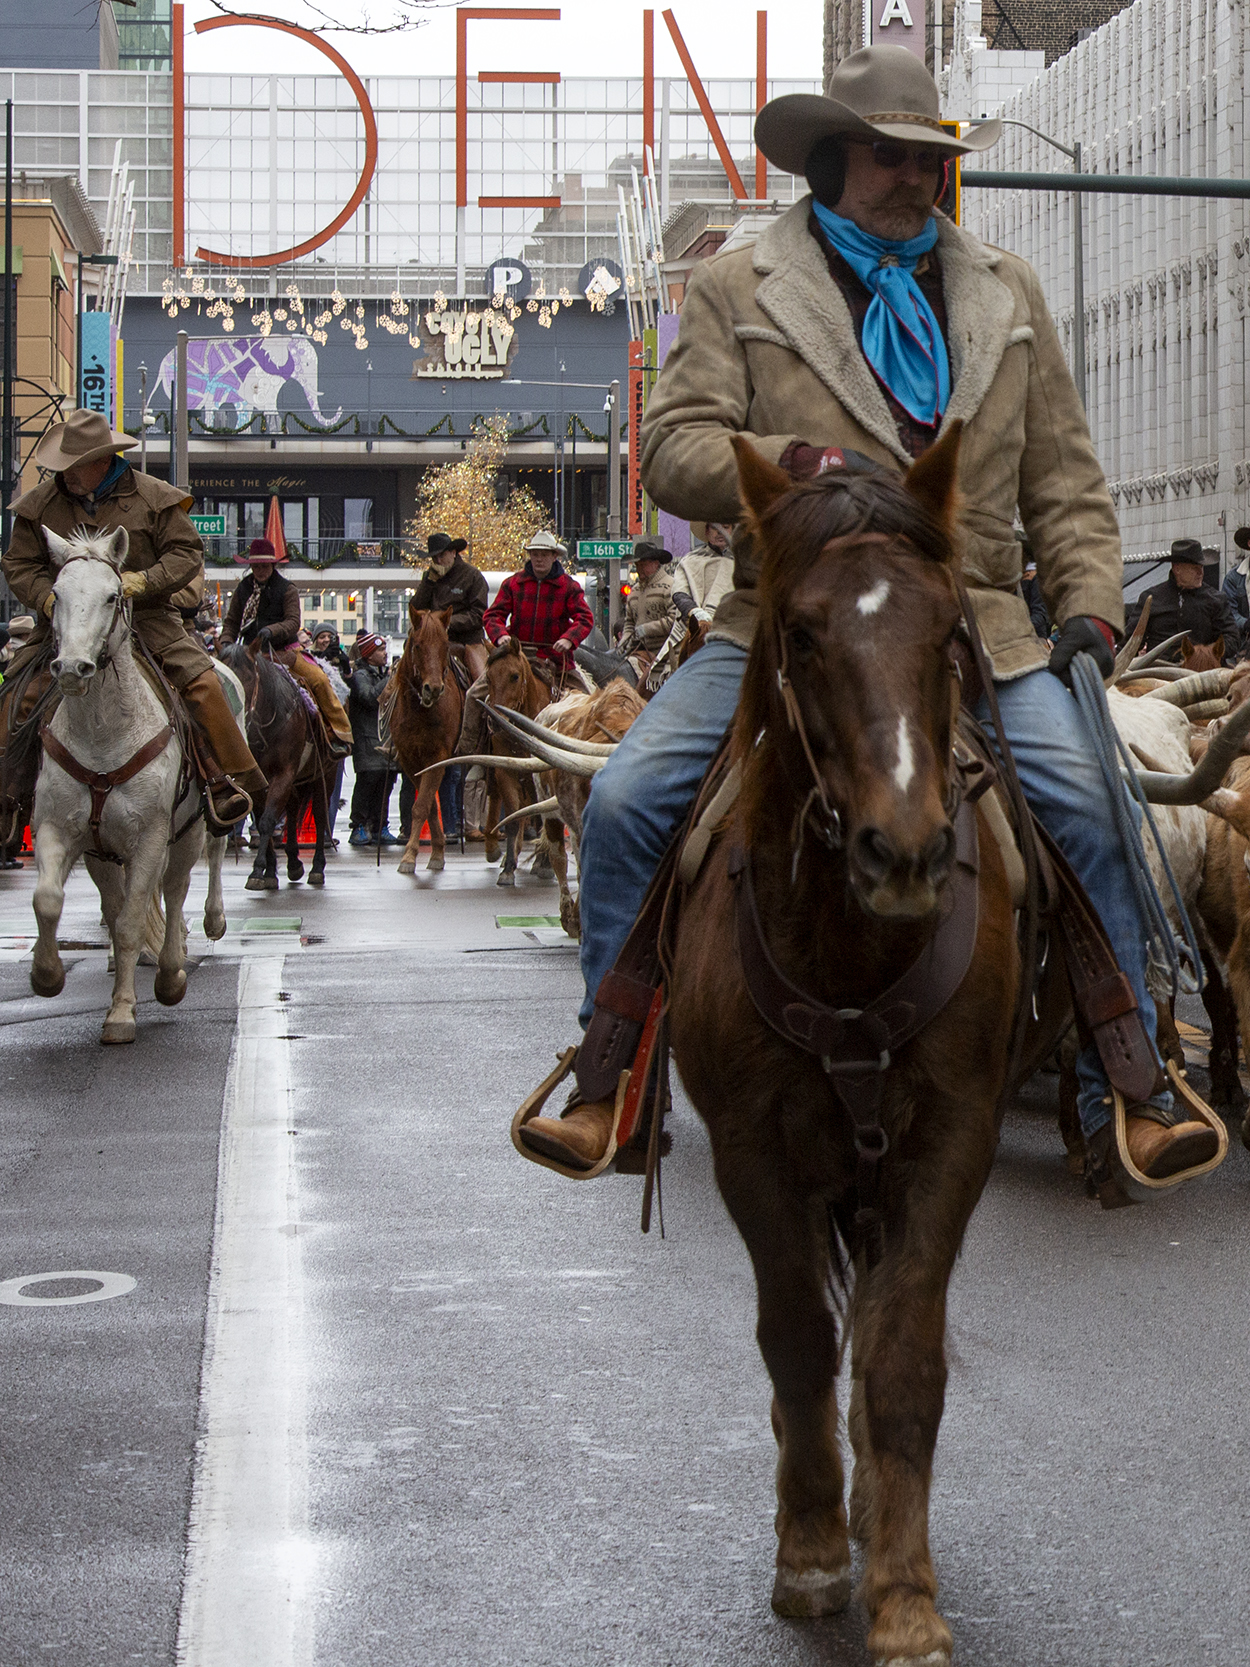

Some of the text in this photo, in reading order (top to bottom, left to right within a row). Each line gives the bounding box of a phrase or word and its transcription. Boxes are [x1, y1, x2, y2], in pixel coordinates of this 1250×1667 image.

[494, 266, 523, 294] P
[444, 333, 513, 365] UGLY
[242, 479, 260, 487] THE
[594, 544, 615, 556] 16th
